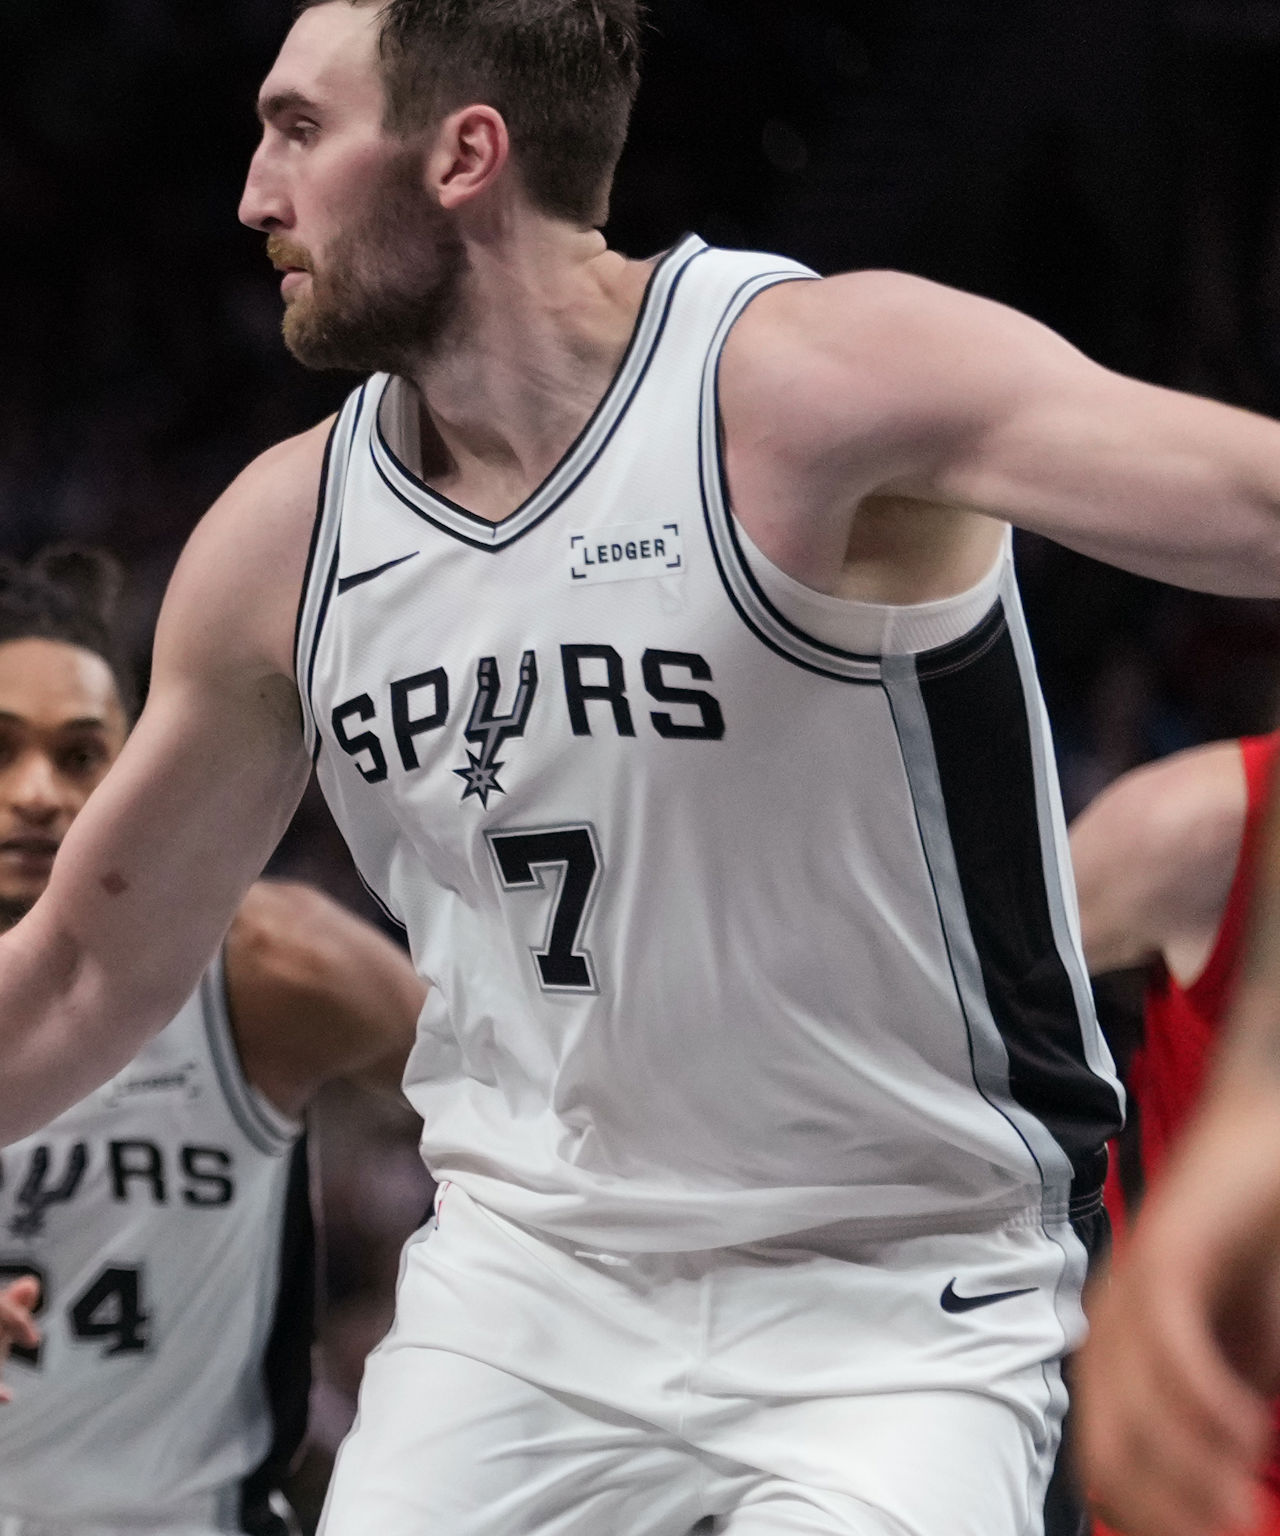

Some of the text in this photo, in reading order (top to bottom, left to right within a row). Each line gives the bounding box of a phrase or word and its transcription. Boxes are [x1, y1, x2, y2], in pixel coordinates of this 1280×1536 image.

[583, 538, 666, 566] LEDGER
[331, 643, 726, 809] SPURS
[485, 821, 604, 996] 7
